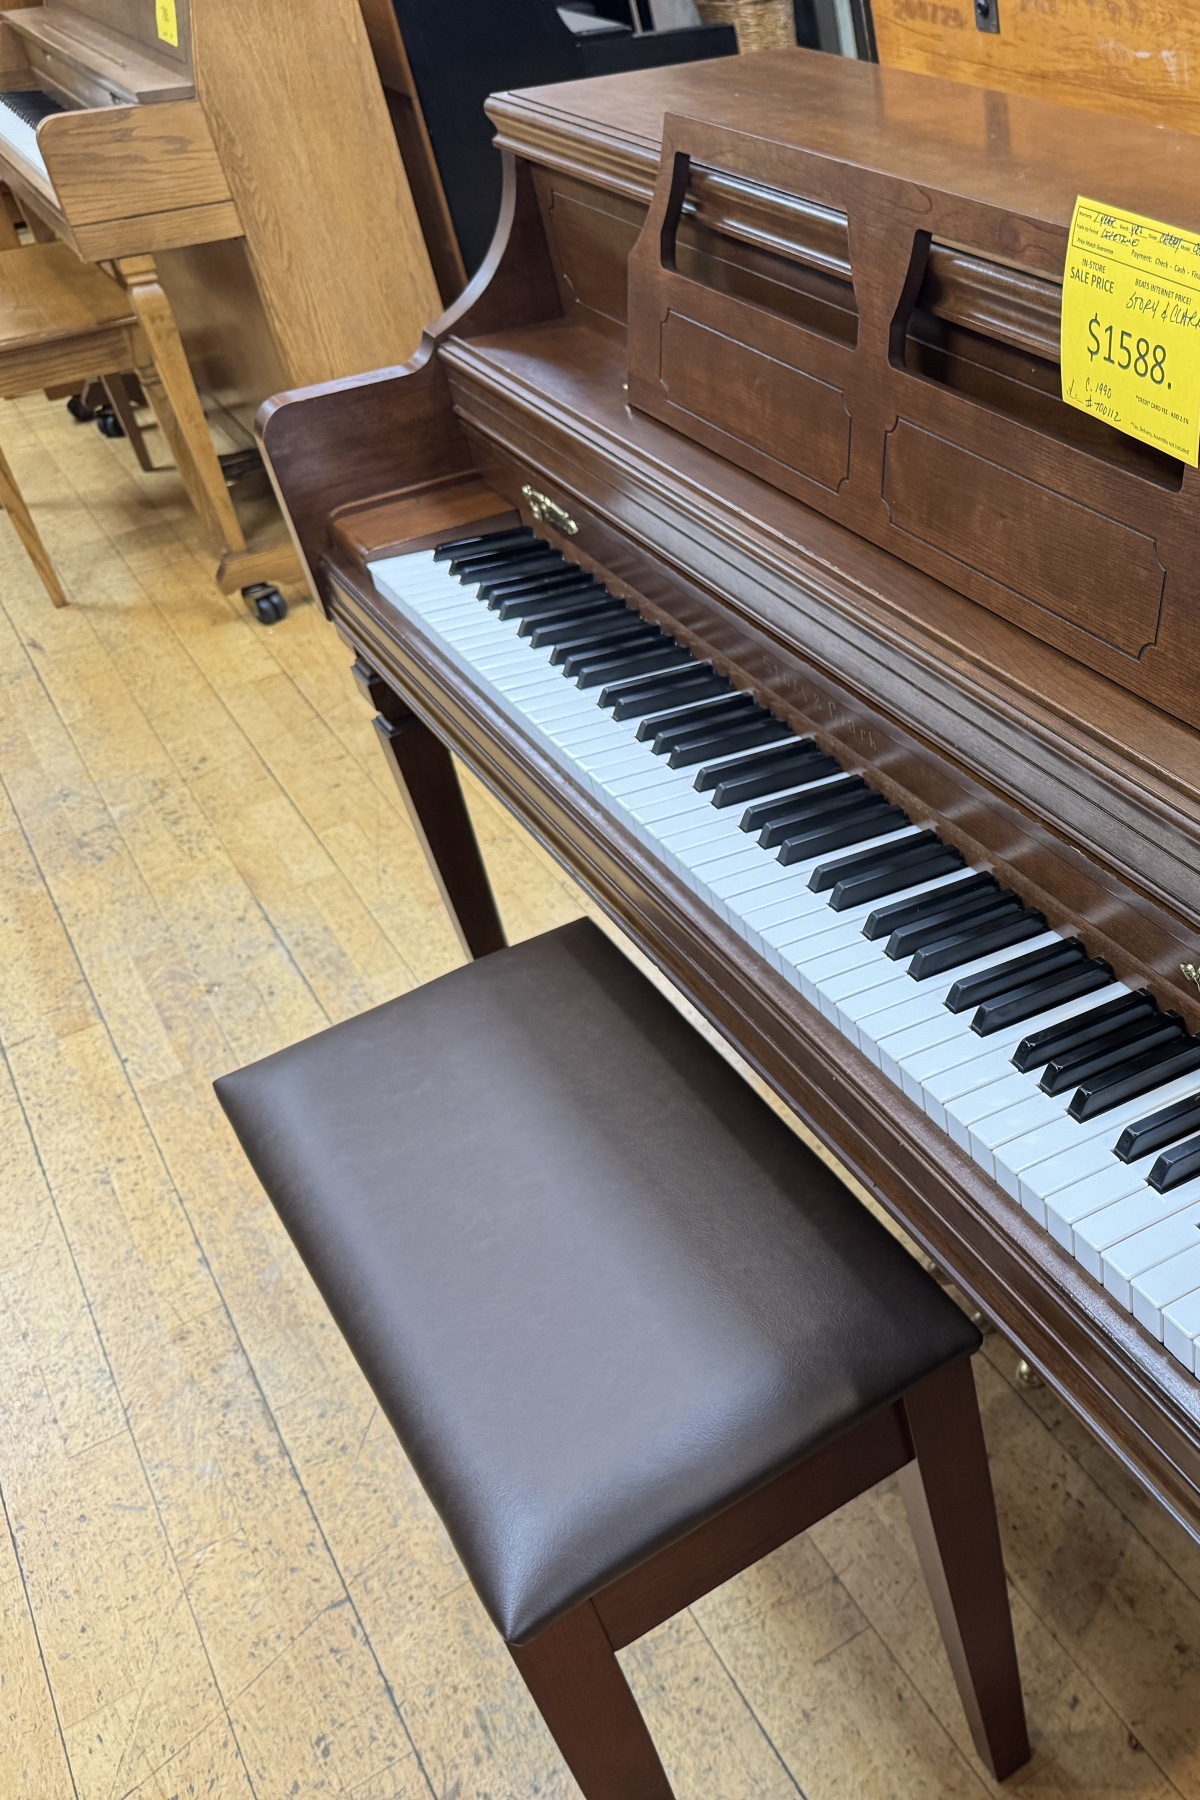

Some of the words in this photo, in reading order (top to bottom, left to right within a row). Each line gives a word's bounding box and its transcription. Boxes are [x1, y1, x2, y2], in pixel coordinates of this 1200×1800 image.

[1077, 237, 1086, 245] Price
[1086, 240, 1097, 249] Match
[1096, 244, 1114, 255] Guarantee
[1082, 258, 1106, 274] IN-STORE
[1131, 249, 1152, 263] Payment:
[1155, 257, 1168, 268] Check
[1174, 264, 1186, 274] Cash
[1070, 266, 1090, 284] SALE
[1091, 274, 1114, 294] PRICE
[1135, 278, 1150, 290] BEATS
[1150, 285, 1175, 299] INTERNET
[1174, 292, 1192, 306] PRICE!
[1126, 292, 1160, 319] STORY
[1161, 302, 1170, 322] &
[1087, 312, 1172, 390] $1588.
[1095, 383, 1112, 399] 1990
[1151, 402, 1162, 412] CARD
[1171, 411, 1180, 420] ADD
[762, 655, 808, 704] Story
[828, 701, 877, 752] Clark
